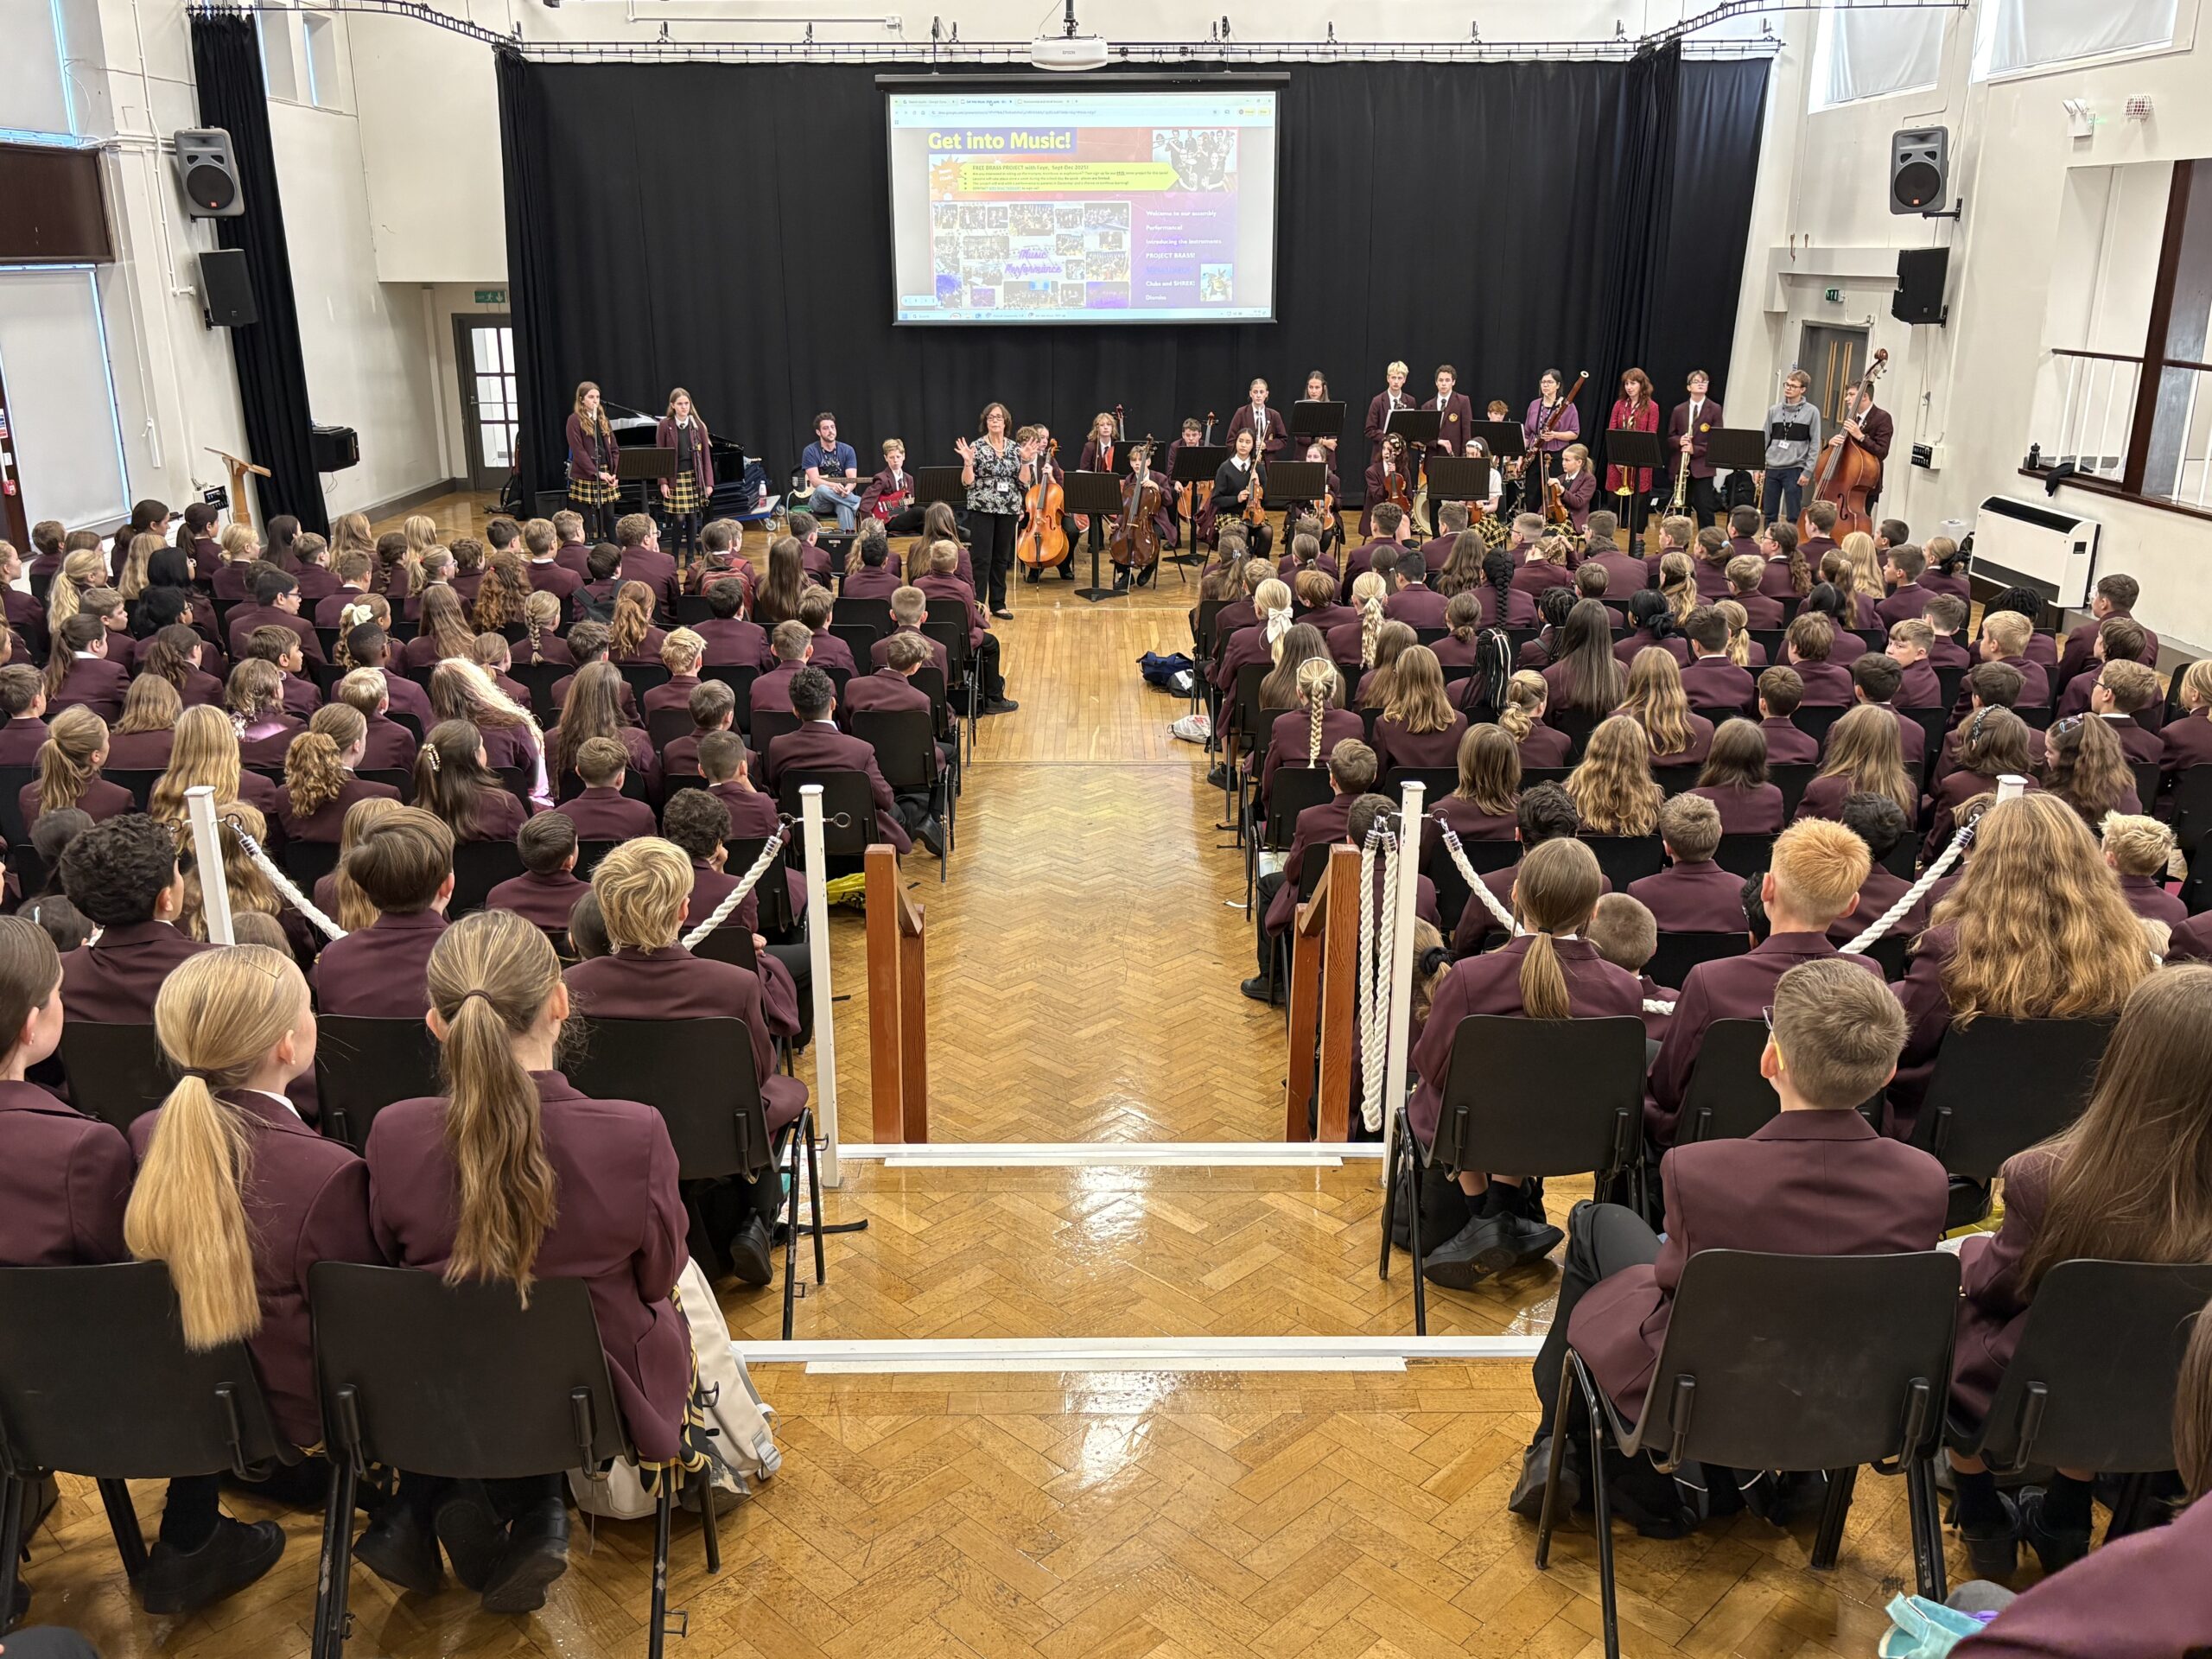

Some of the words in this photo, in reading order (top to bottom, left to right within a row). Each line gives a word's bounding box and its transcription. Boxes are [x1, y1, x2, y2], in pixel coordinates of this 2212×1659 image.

[928, 132, 962, 149] Get
[966, 131, 1005, 149] into
[1010, 131, 1071, 149] Music!
[1019, 249, 1049, 260] Music
[1005, 263, 1063, 277] Performance
